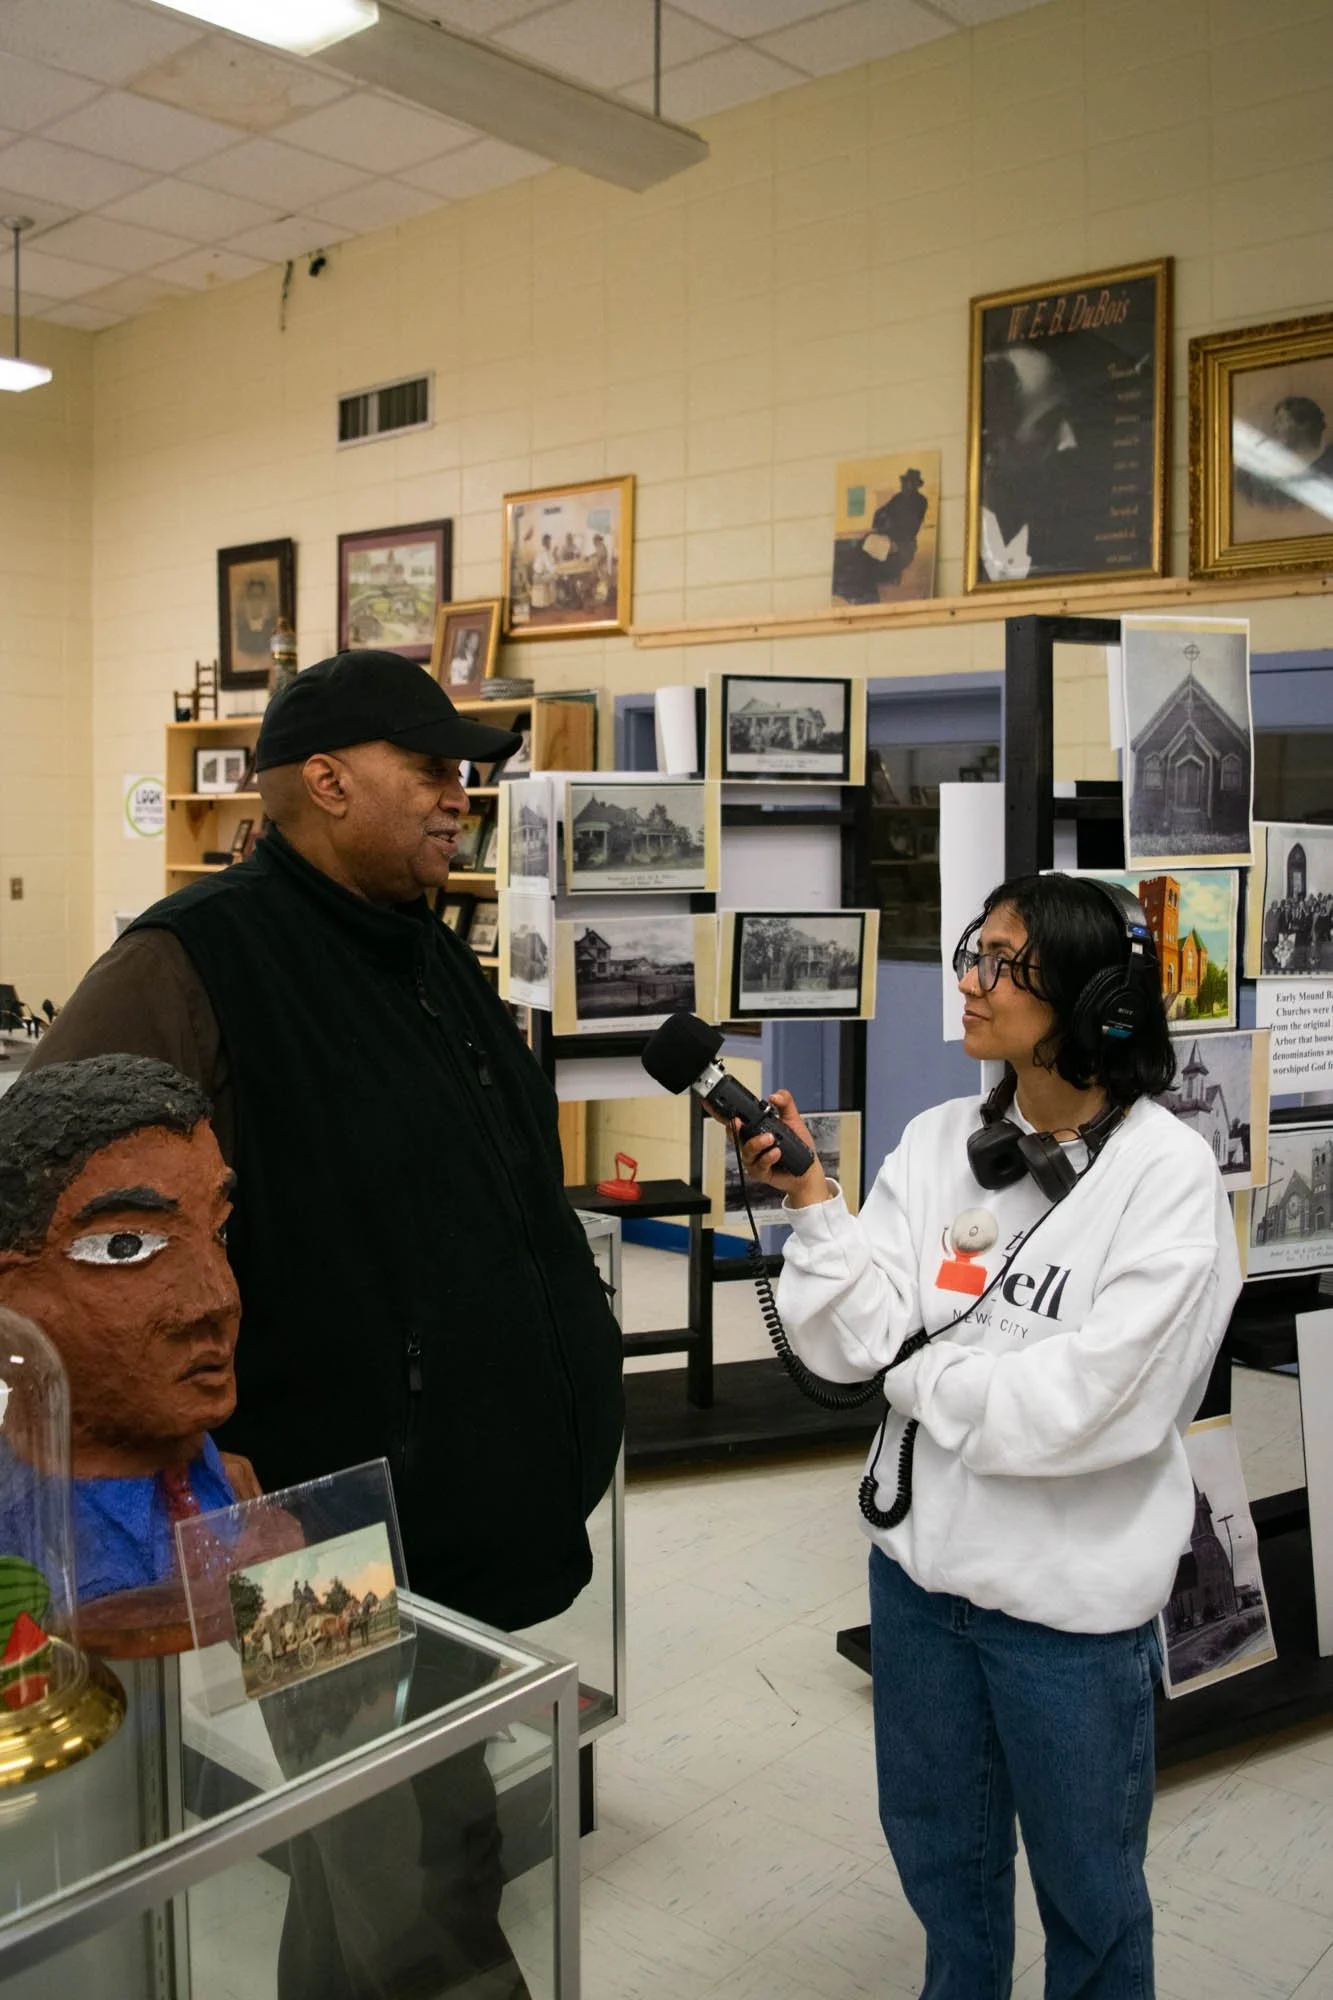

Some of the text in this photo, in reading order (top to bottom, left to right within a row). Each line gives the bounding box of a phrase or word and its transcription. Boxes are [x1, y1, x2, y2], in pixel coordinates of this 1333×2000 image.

[1275, 992, 1296, 1004] Early
[1299, 991, 1325, 1001] Mound
[1275, 1006, 1311, 1017] Churches
[1312, 1006, 1330, 1014] were
[1270, 1019, 1331, 1031] from the original
[1275, 1037, 1296, 1046] Arbor
[1298, 1035, 1312, 1044] that
[1272, 1049, 1325, 1061] denominations
[1272, 1063, 1310, 1075] worshiped
[1311, 1061, 1326, 1071] God
[1000, 1318, 1028, 1340] CITY
